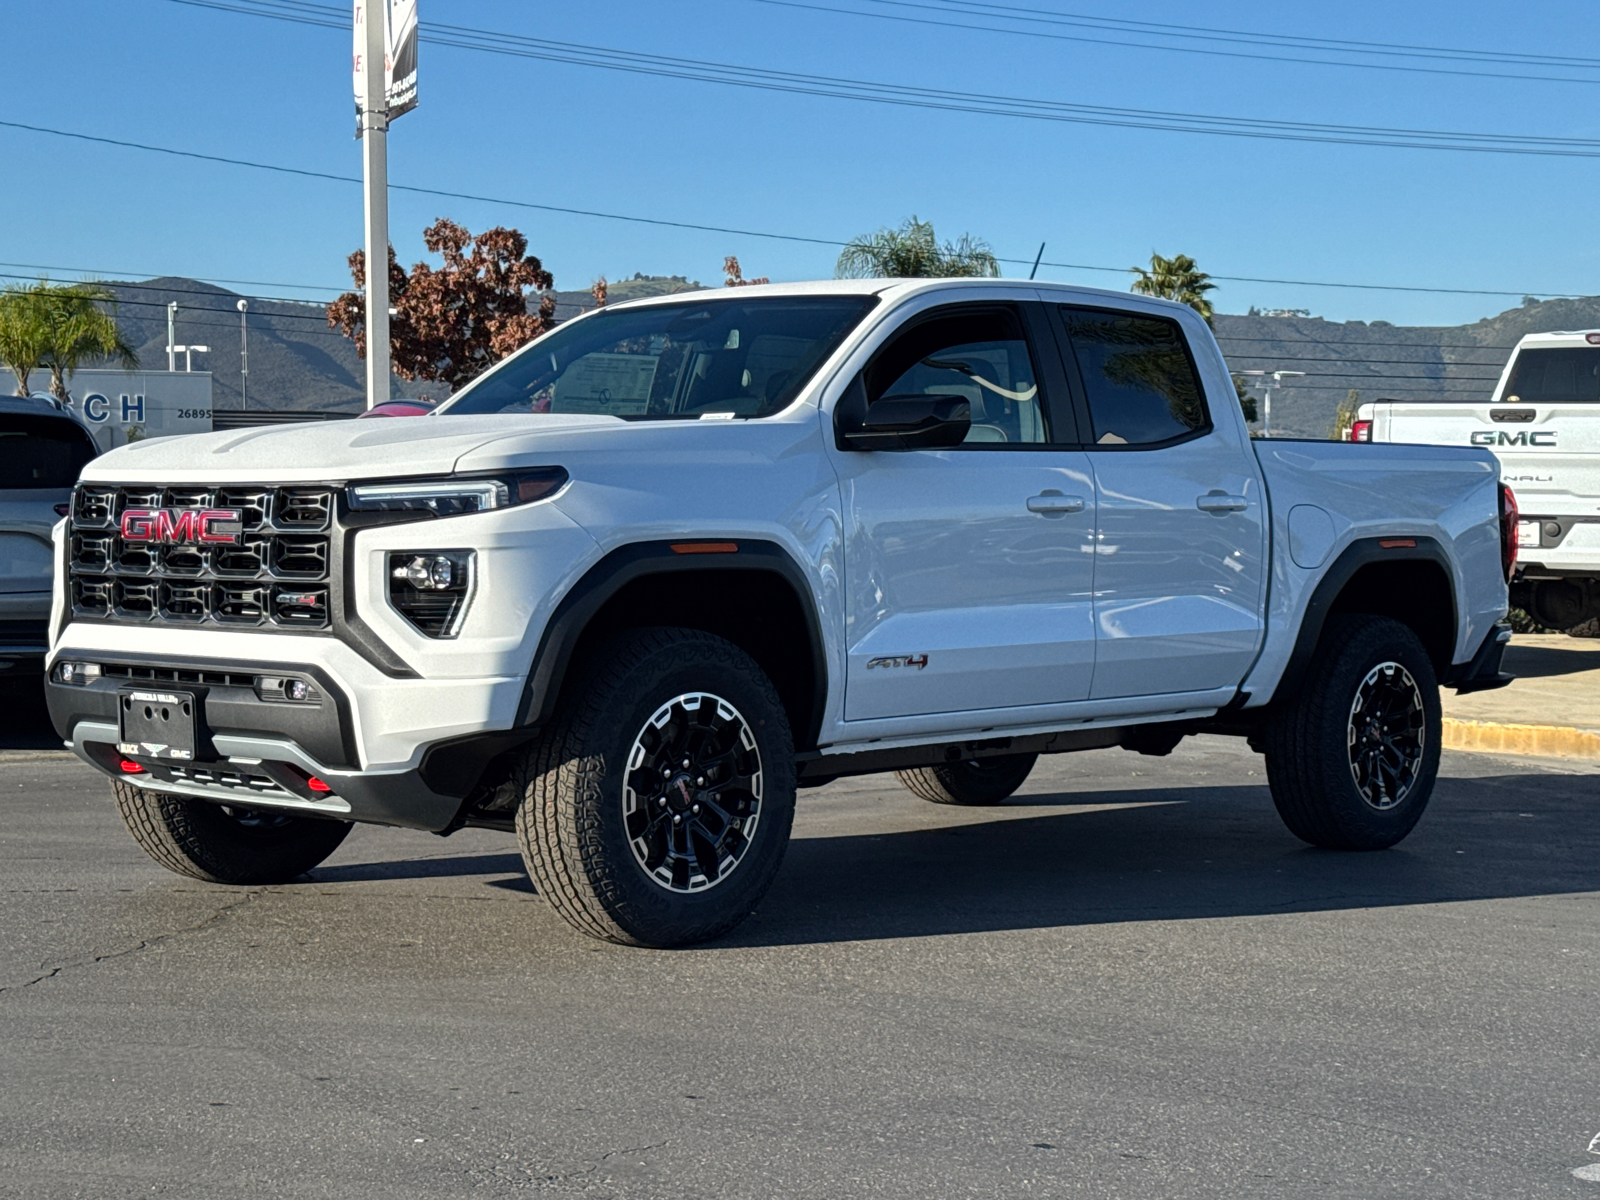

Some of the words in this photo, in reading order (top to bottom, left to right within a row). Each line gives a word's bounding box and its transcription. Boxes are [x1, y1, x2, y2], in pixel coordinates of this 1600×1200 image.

[67, 392, 146, 423] CH
[177, 409, 212, 419] 26895
[1470, 431, 1558, 447] GMC
[121, 508, 242, 545] GMC
[866, 654, 928, 670] AT4
[170, 749, 190, 758] GMC
